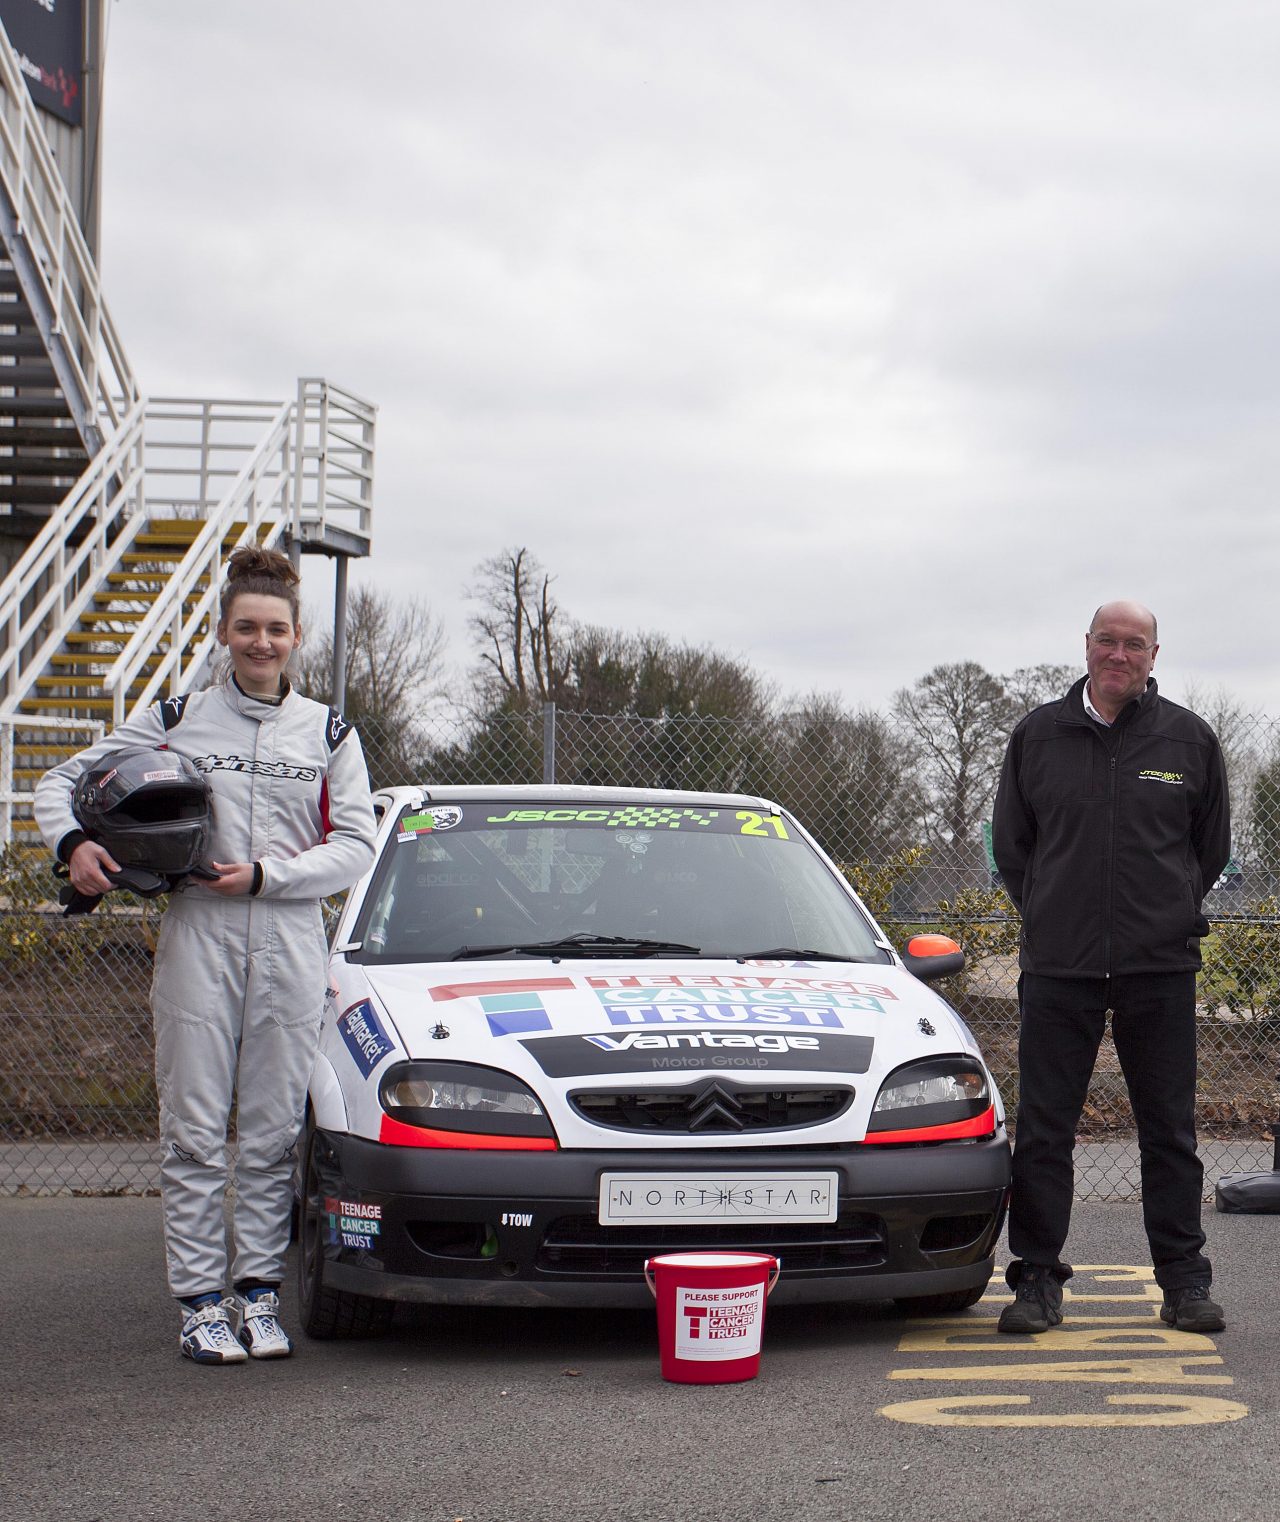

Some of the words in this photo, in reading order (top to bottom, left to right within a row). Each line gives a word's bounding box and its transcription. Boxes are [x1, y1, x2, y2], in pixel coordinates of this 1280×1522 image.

[194, 755, 316, 782] alpinestars
[487, 810, 611, 823] JSCC
[735, 811, 790, 840] 21
[590, 976, 895, 1000] TEENAGE
[604, 989, 882, 1011] CANCER
[610, 1004, 829, 1024] TRUST
[346, 1004, 385, 1065] haymarket
[582, 1032, 820, 1053] Vantage
[652, 1056, 706, 1068] Motor
[711, 1055, 769, 1068] Group
[619, 1189, 821, 1206] NORTHSTAR
[340, 1202, 382, 1219] TEENAGE
[340, 1218, 379, 1234] CANCER
[508, 1213, 533, 1227] TOW
[342, 1233, 371, 1249] TRUST
[684, 1293, 720, 1302] PLEASE
[721, 1289, 759, 1301] SUPPORT
[710, 1302, 759, 1317] TEENAGE
[709, 1315, 755, 1328] CANCER
[709, 1327, 746, 1339] TRUST
